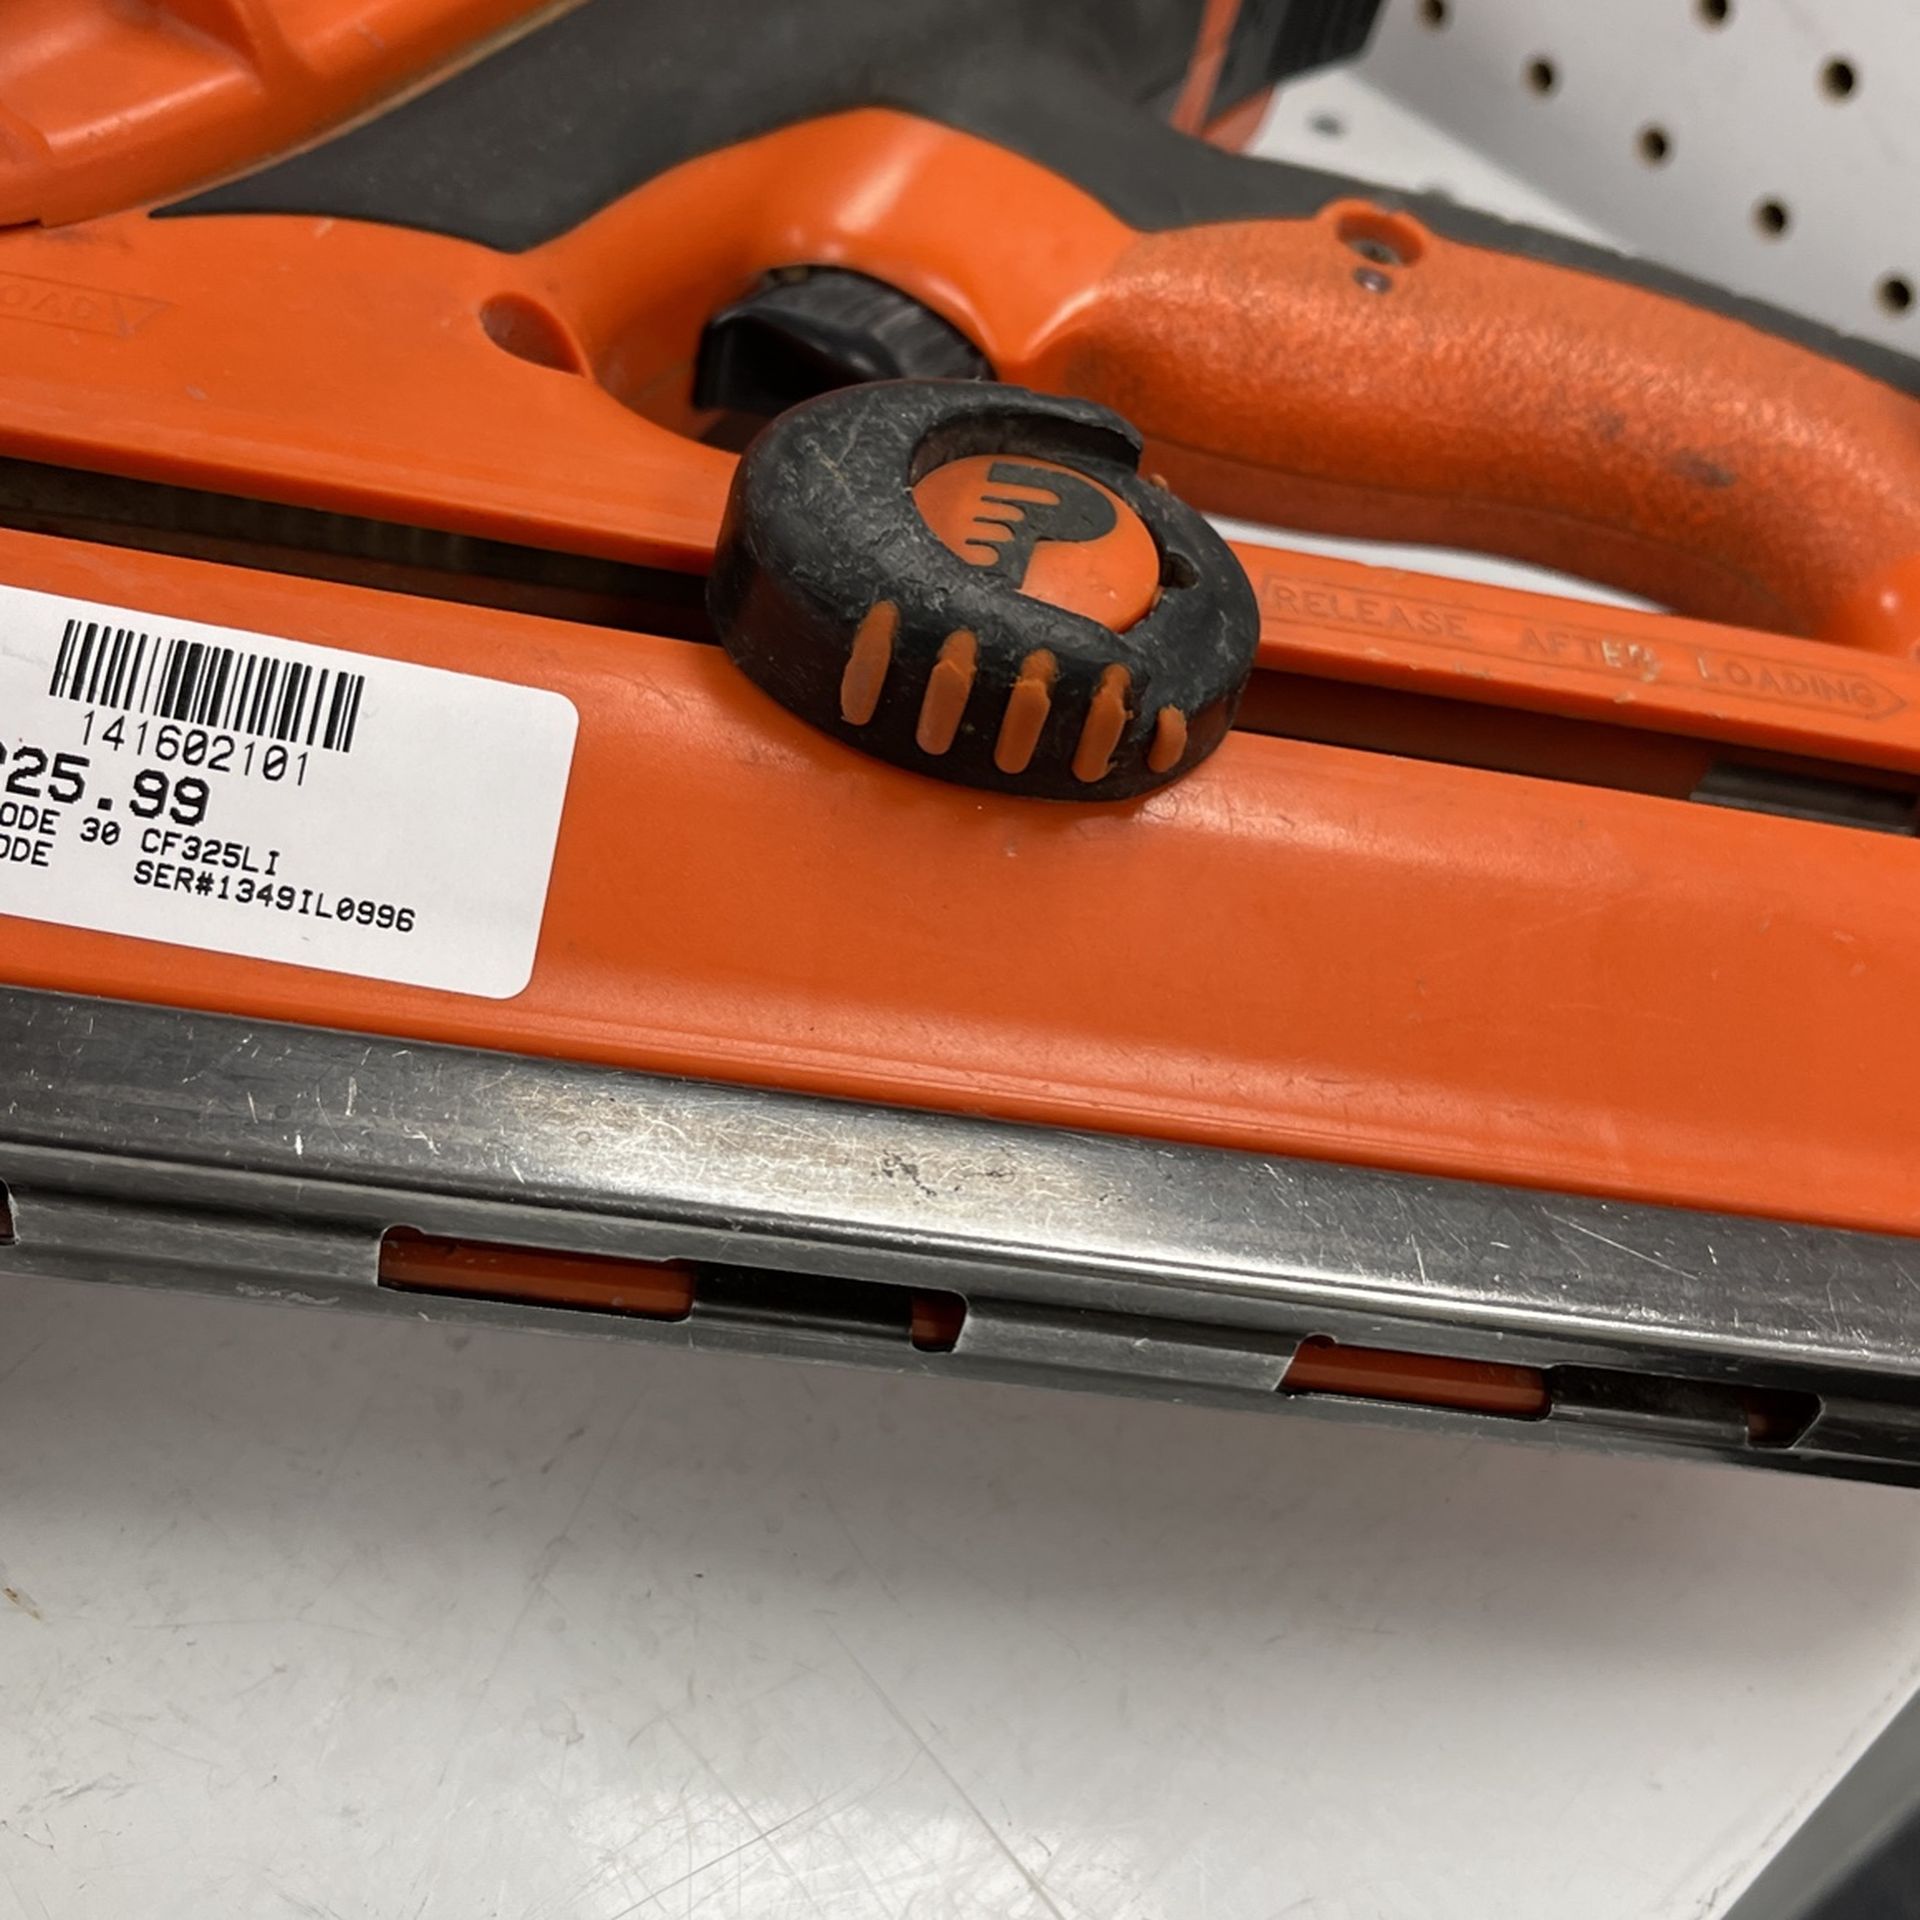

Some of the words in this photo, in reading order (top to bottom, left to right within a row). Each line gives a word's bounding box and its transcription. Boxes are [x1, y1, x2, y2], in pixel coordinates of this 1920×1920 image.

[1272, 584, 1472, 642] RELEASE
[1517, 627, 1660, 682] AFTER
[1695, 655, 1878, 708] LOADING
[0, 741, 211, 827] 25.99
[83, 710, 308, 786] 141602101
[80, 817, 121, 846] 30
[140, 828, 280, 876] CF325LI
[134, 860, 416, 933] SER#1349IL0996
